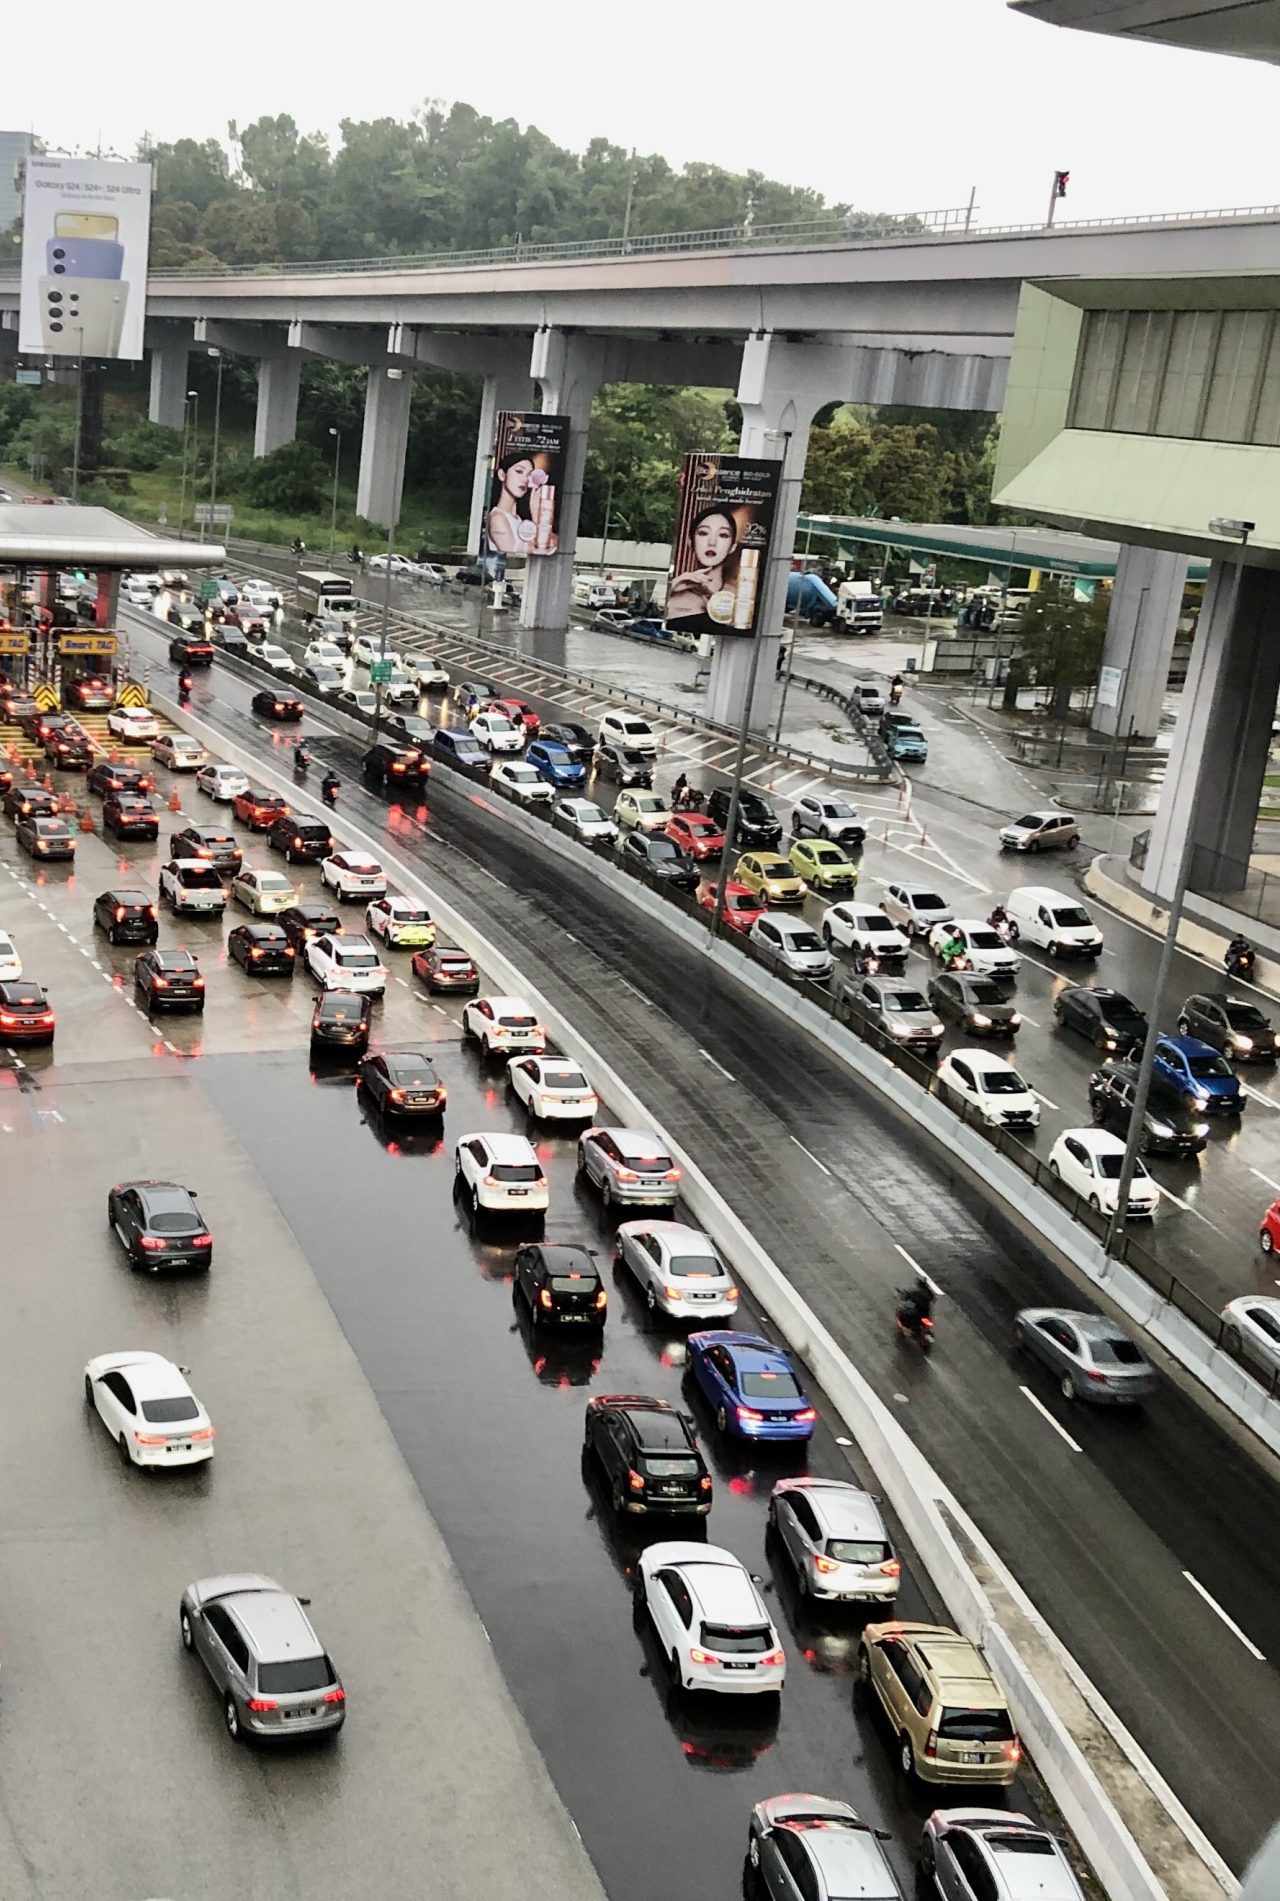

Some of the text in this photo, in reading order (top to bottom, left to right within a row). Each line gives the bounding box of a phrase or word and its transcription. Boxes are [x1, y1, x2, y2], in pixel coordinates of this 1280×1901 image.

[35, 180, 65, 191] Galaxy
[66, 182, 80, 190] S24
[106, 184, 120, 193] S24
[121, 185, 141, 195] Ultra
[714, 485, 772, 497] Penghidratan
[65, 640, 92, 649] Smart
